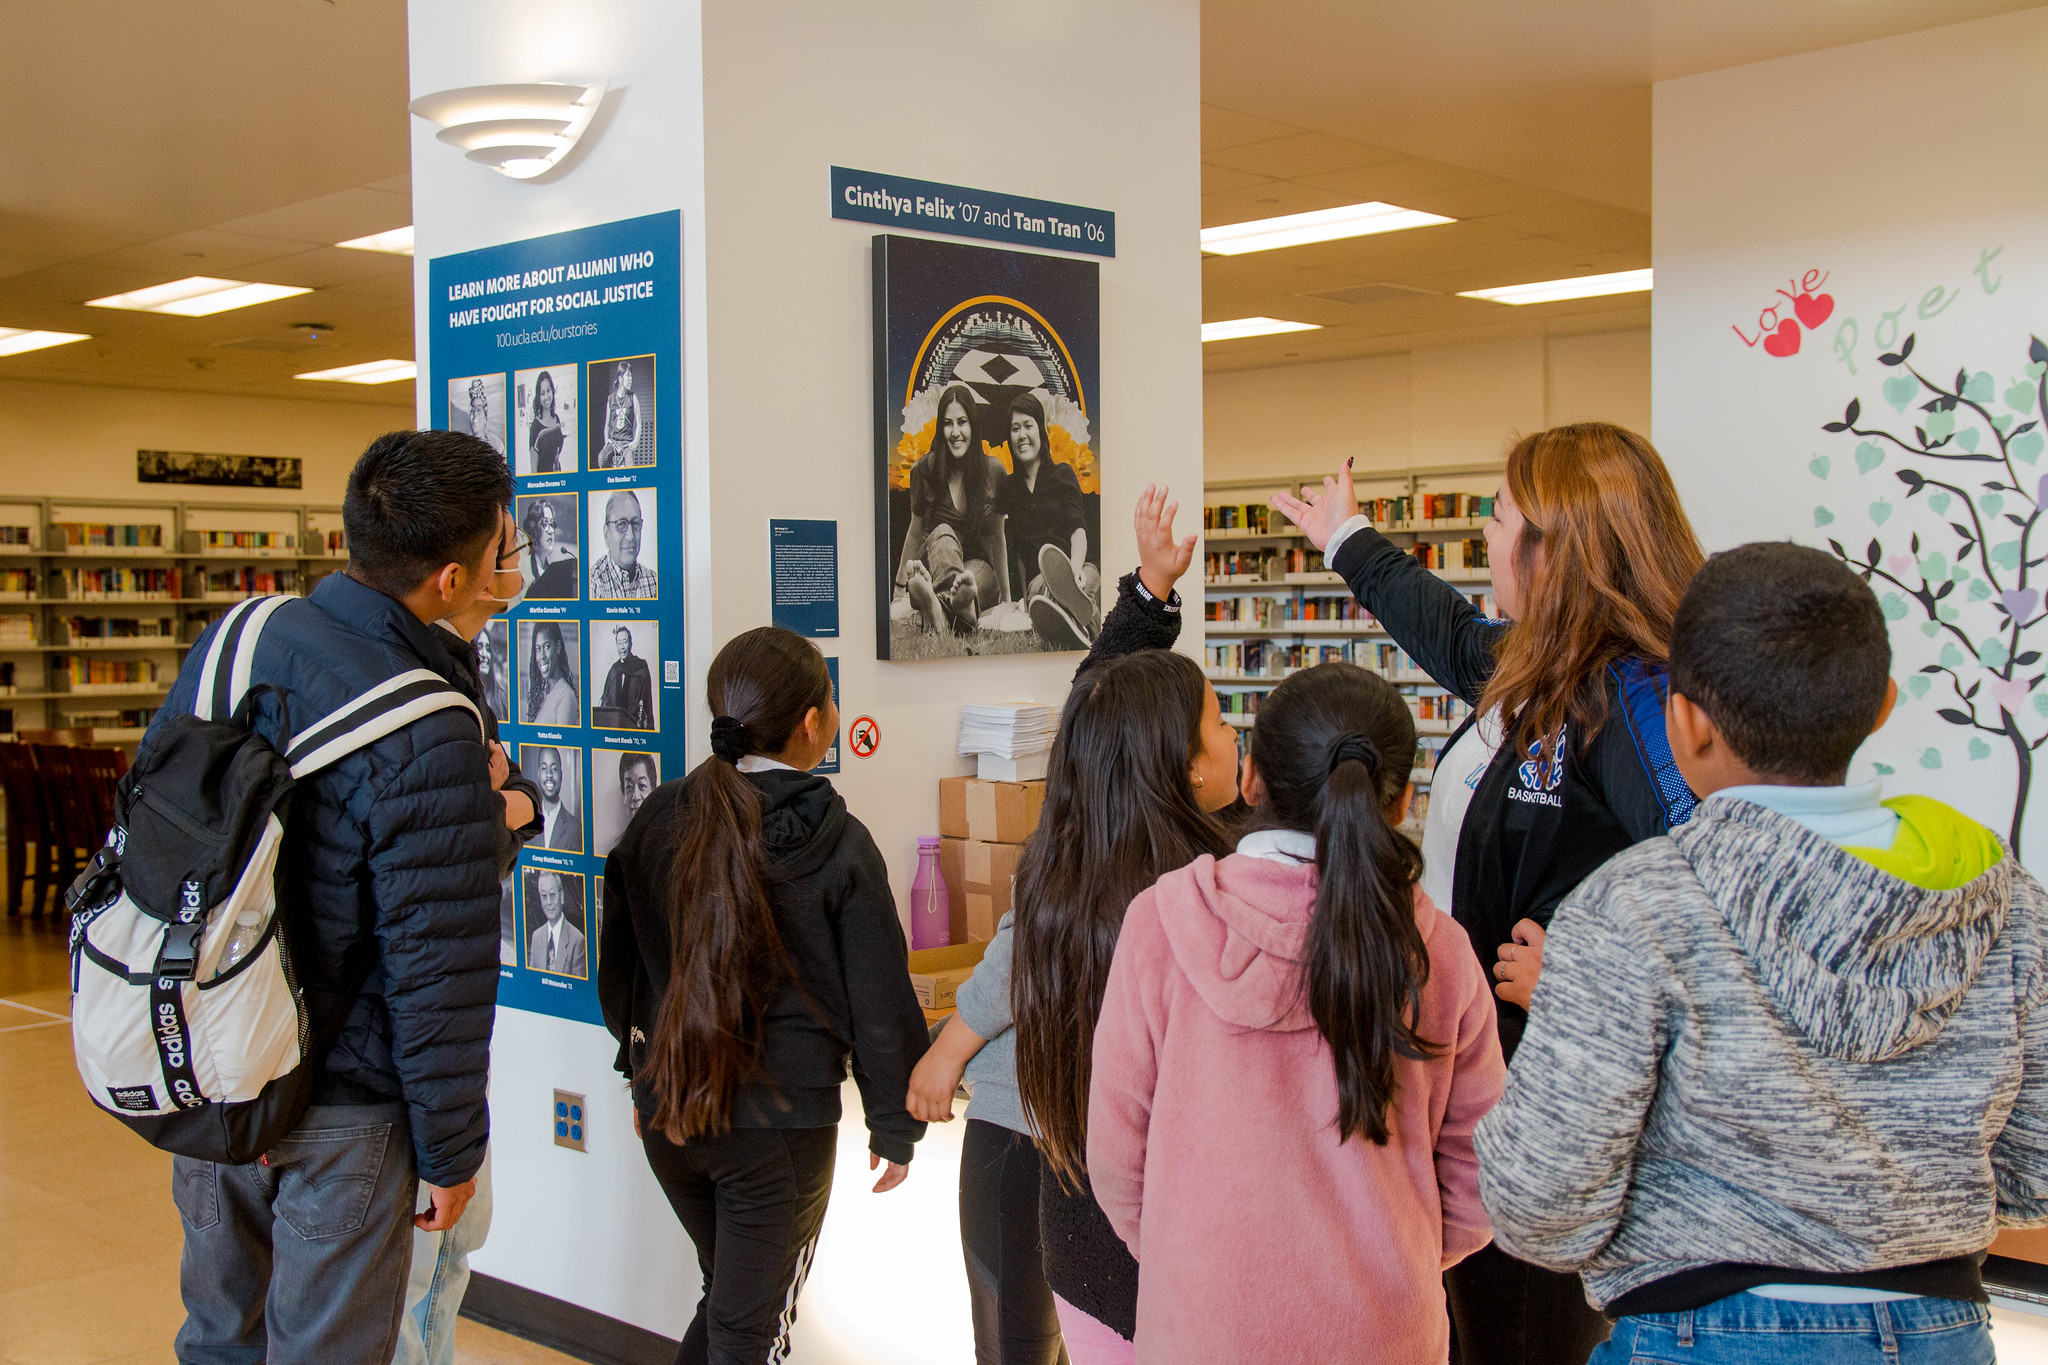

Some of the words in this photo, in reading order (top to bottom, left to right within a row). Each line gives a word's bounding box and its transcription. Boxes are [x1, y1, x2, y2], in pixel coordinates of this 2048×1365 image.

[844, 185, 912, 217] Cinthya
[916, 196, 956, 221] Felix
[958, 201, 981, 223] '07
[983, 208, 1011, 228] and
[1013, 211, 1045, 234] Tam
[1048, 217, 1081, 239] Tran
[1084, 221, 1105, 243] '06
[449, 280, 485, 302] LEARN
[486, 273, 521, 294] MORE
[522, 266, 565, 288] ABOUT
[566, 257, 617, 281] ALUMNI
[619, 250, 655, 272] WHO
[449, 309, 480, 329] HAVE
[481, 300, 528, 324] FOUGHT
[530, 296, 554, 316] FOR
[555, 289, 601, 312] SOCIAL
[602, 280, 654, 305] JUSTICE
[495, 320, 598, 348] 100.ucla.edu/ourstories
[157, 1002, 185, 1068] adidas
[115, 1089, 146, 1098] adidas
